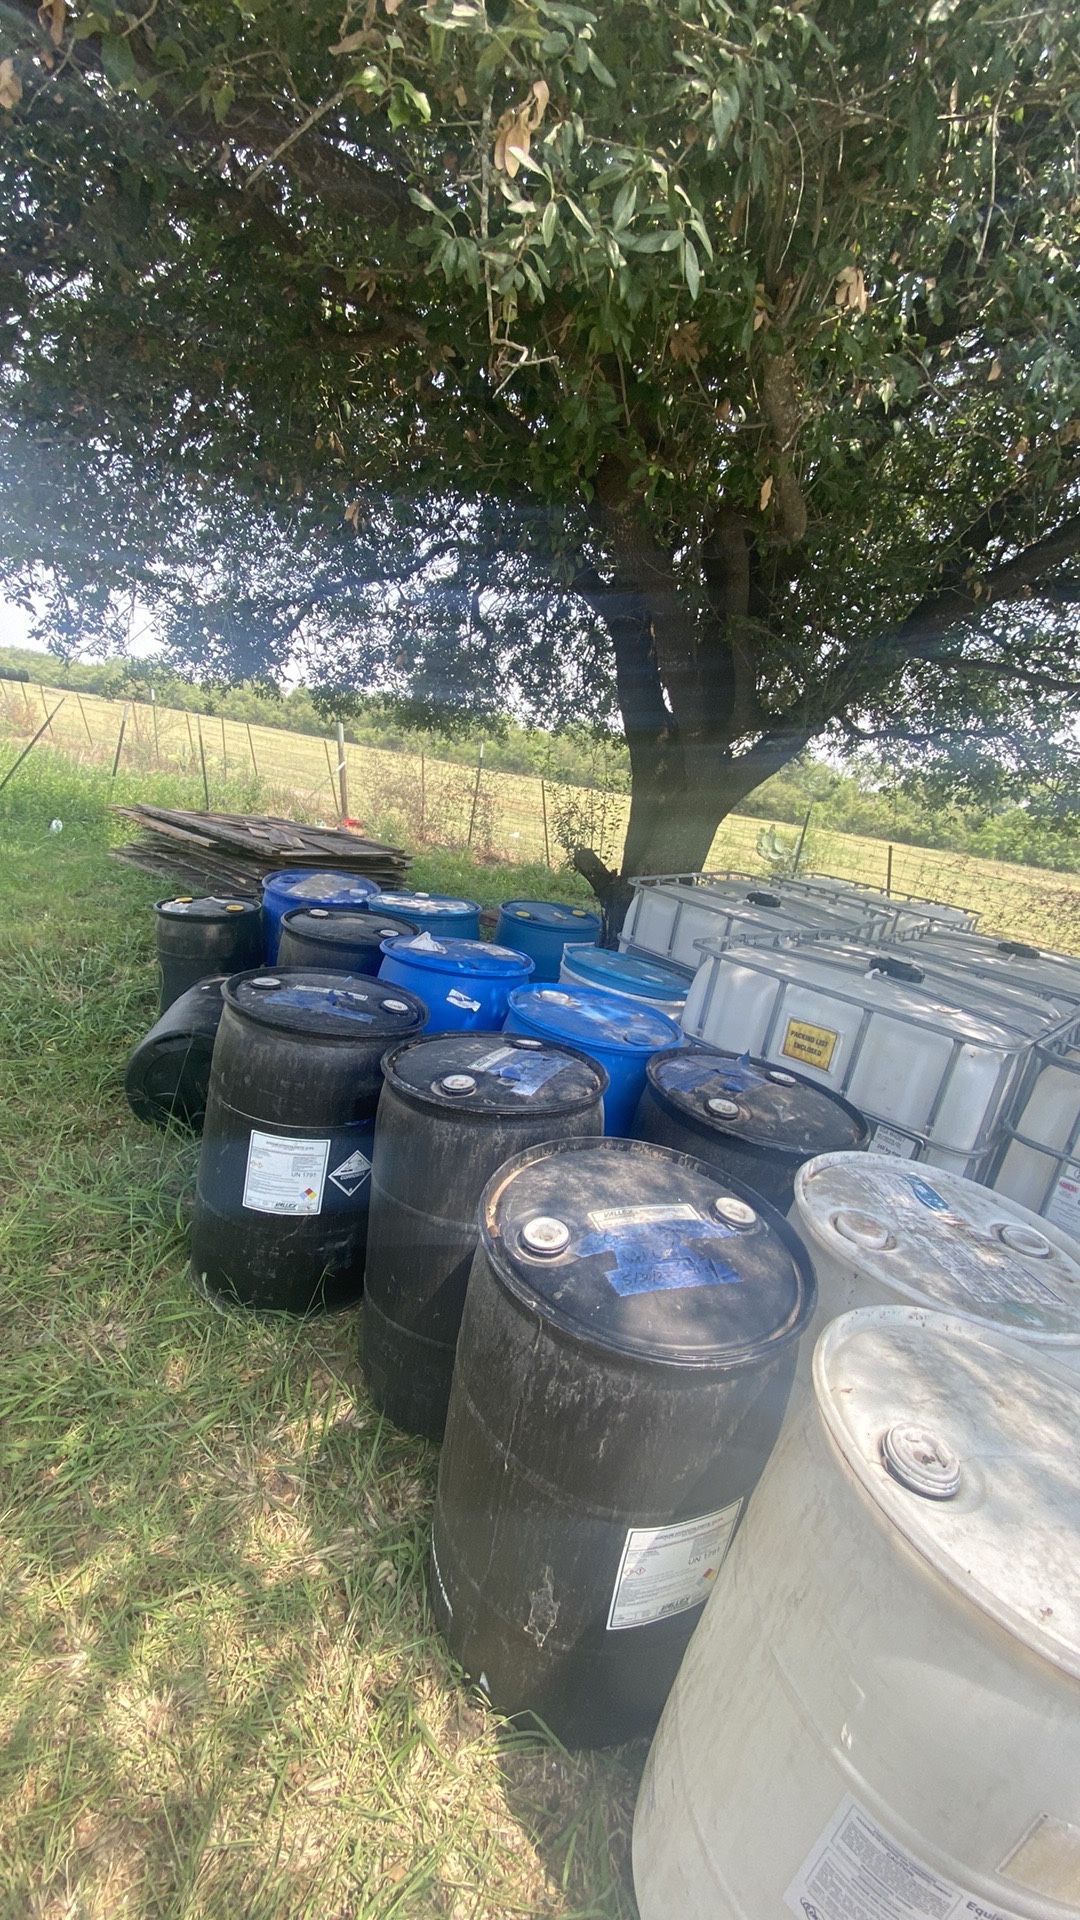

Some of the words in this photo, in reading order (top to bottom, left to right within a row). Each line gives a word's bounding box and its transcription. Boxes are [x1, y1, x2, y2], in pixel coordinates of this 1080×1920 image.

[790, 1031, 815, 1043] PACKING
[815, 1038, 828, 1047] LIST
[793, 1041, 822, 1056] ENCLOSED
